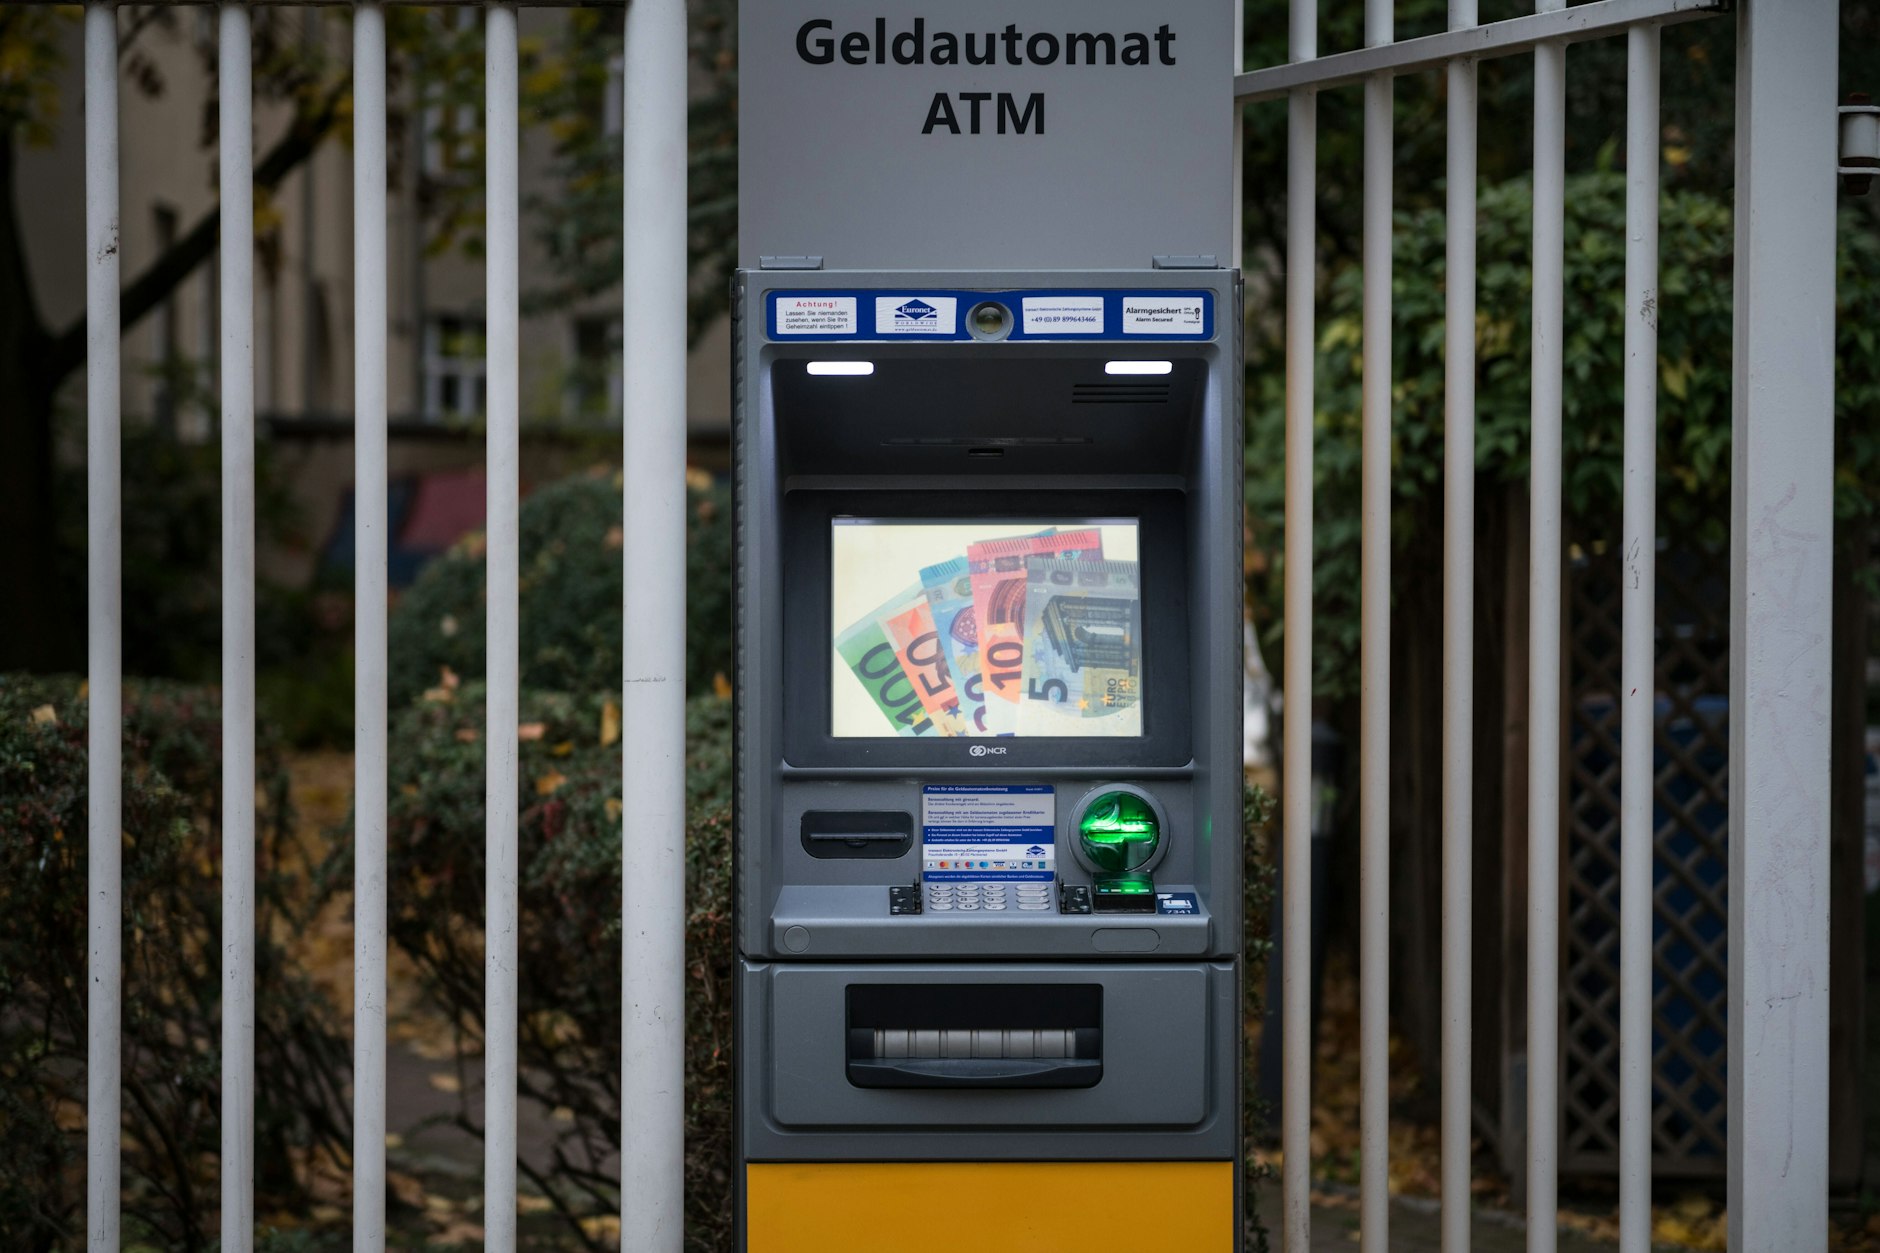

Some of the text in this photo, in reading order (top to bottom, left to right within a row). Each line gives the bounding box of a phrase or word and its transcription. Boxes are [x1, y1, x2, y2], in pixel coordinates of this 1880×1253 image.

[795, 17, 1177, 66] Geldautomat
[921, 93, 1046, 135] ATM
[901, 305, 931, 314] Euronet
[1125, 307, 1182, 316] Alarmgesichert
[906, 631, 951, 697] 50
[987, 642, 1023, 691] 10
[1028, 678, 1068, 702] 5
[1106, 678, 1117, 708] EURO
[987, 747, 1007, 755] NCR
